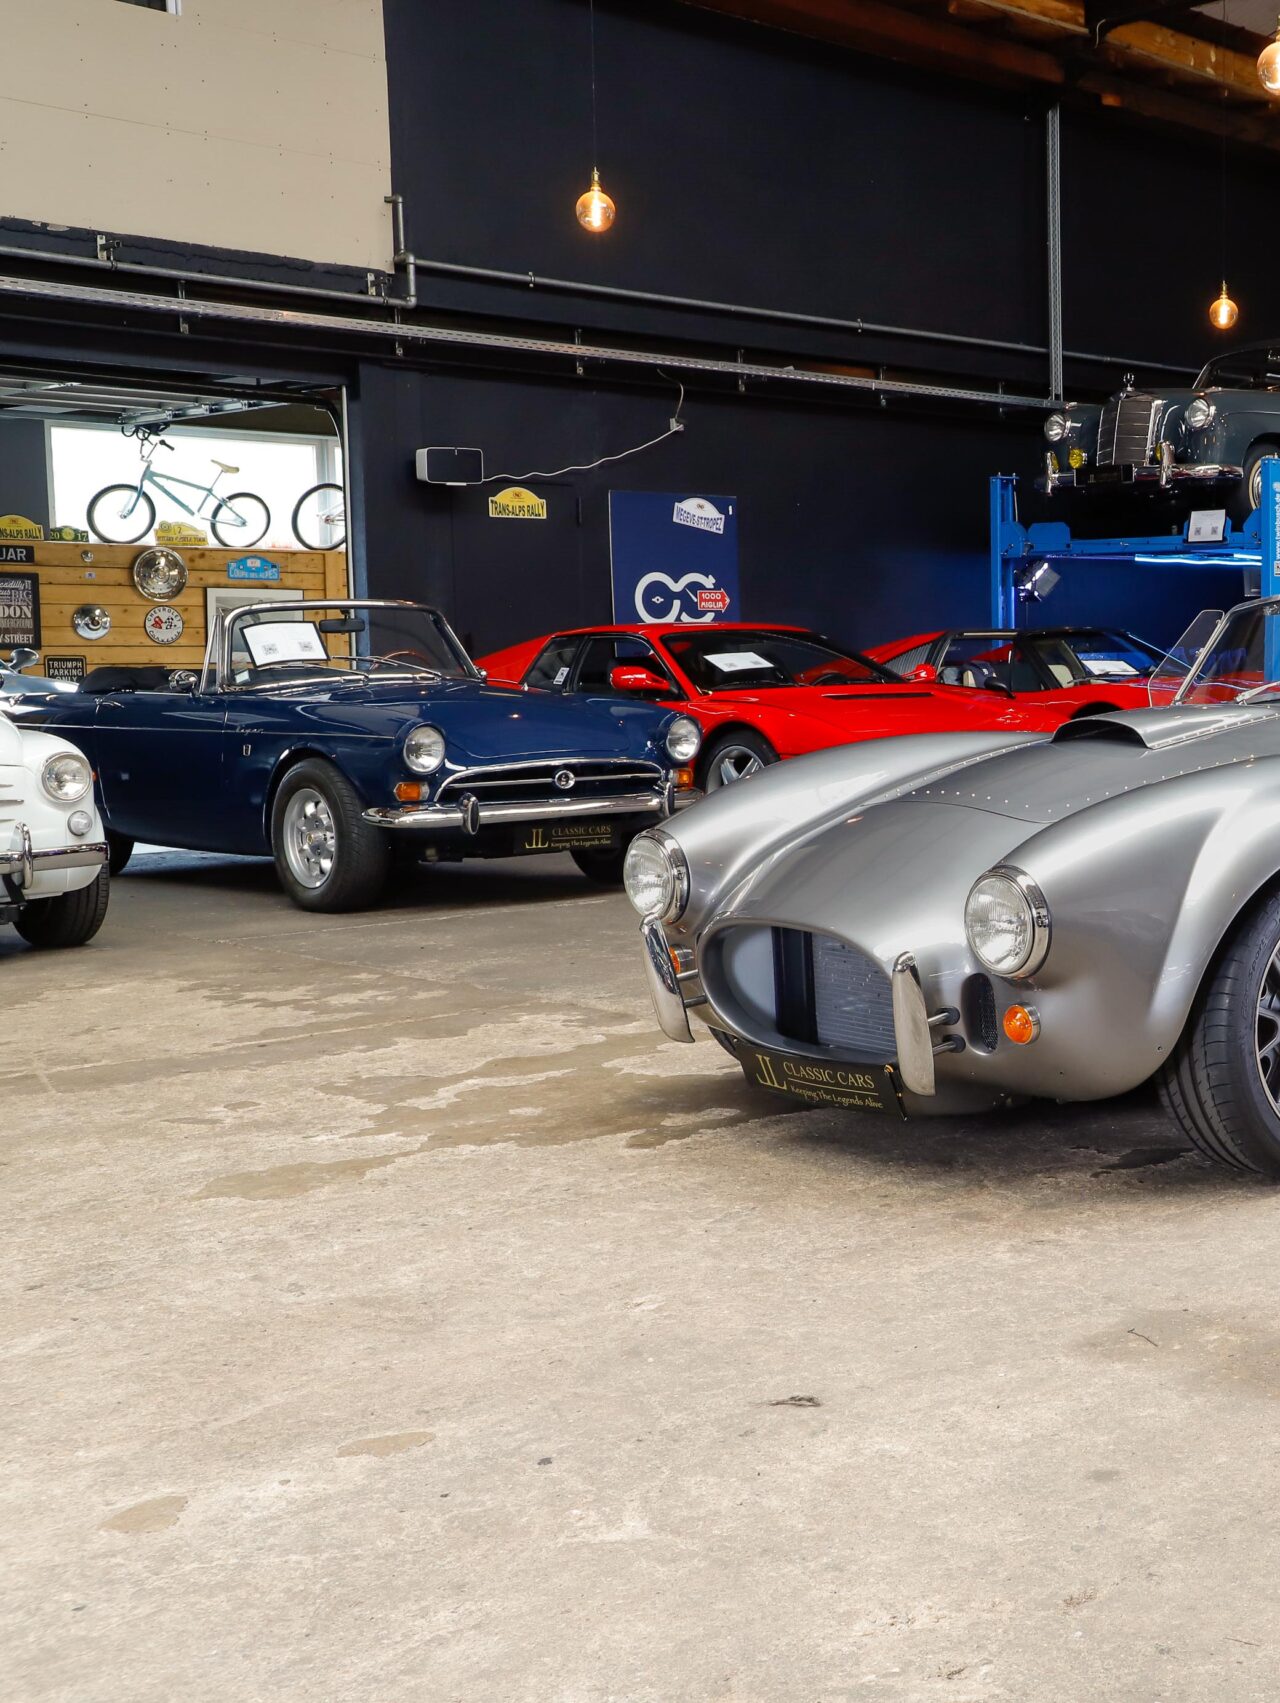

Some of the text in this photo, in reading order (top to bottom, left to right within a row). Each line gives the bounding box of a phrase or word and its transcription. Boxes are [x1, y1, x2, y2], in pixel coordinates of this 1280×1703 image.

[490, 499, 545, 517] TRANS-ALPS RALLY
[24, 527, 42, 539] RALLY
[50, 531, 88, 541] 20 17
[701, 601, 723, 609] MIGLIA
[147, 607, 180, 622] CHEVROLET
[4, 634, 33, 643] STREET
[552, 827, 587, 836] CLASSIC
[589, 825, 611, 834] CARS
[783, 1061, 836, 1083] CLASSIC
[837, 1071, 875, 1089] CARS
[790, 1084, 818, 1102] Keeping
[832, 1093, 864, 1107] Legends
